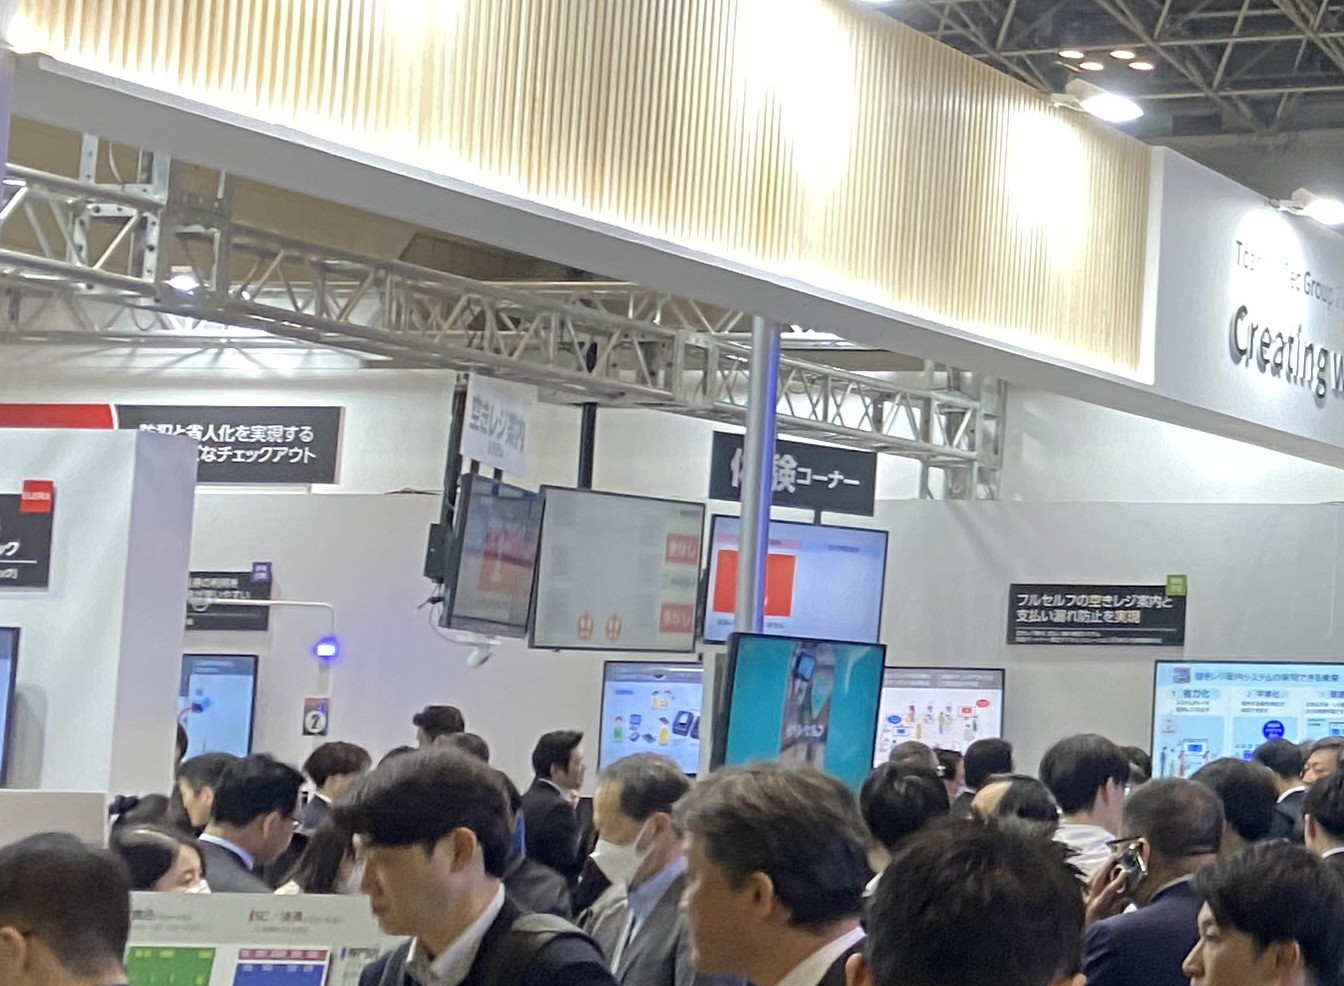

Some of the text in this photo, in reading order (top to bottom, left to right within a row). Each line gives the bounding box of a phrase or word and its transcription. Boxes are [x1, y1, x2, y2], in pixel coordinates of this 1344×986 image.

[1230, 305, 1329, 400] Creating
[1017, 594, 1173, 609] フルセルフの空きレジ案内と
